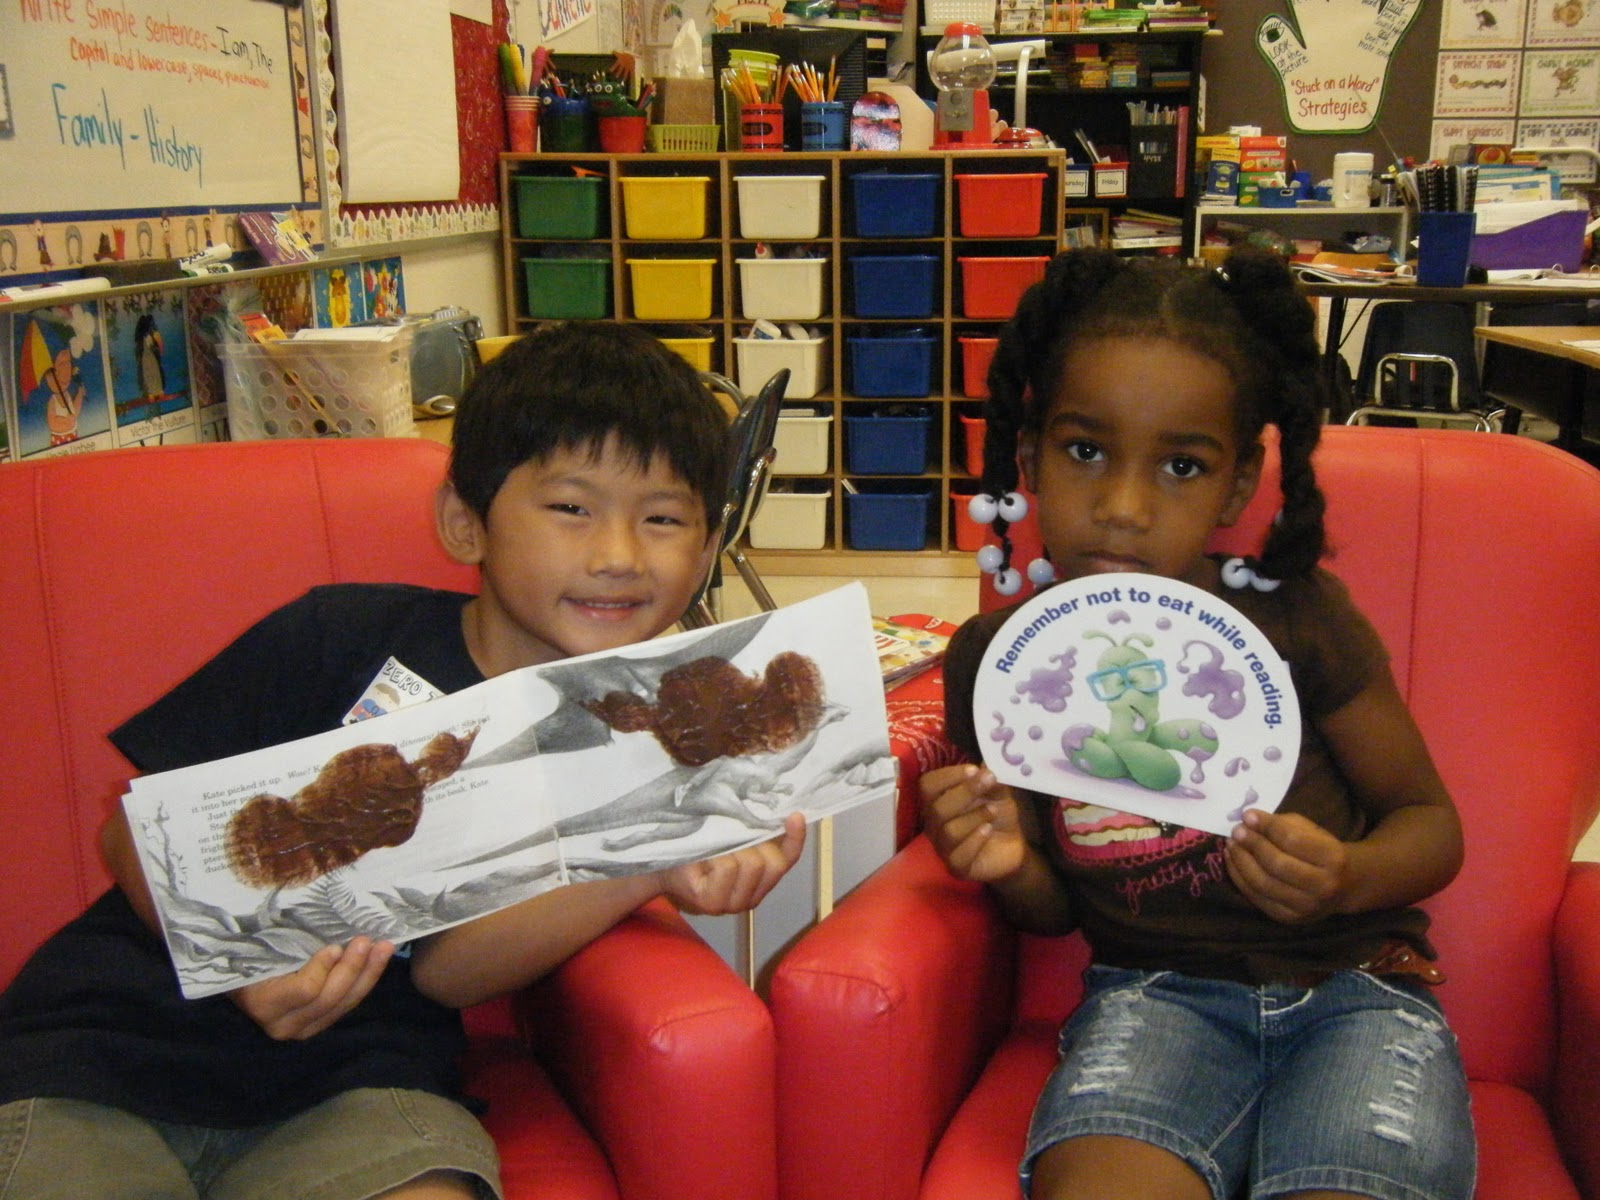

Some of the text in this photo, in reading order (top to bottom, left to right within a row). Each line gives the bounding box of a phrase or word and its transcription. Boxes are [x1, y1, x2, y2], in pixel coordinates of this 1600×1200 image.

[86, 0, 138, 50] Simple
[252, 42, 273, 74] The
[1279, 55, 1309, 81] picture
[1323, 80, 1336, 90] on
[1338, 79, 1347, 91] a
[1298, 97, 1368, 121] Strategies
[51, 82, 125, 170] Family
[143, 102, 203, 189] History
[995, 587, 1283, 729] Remember not to eat while reading.
[382, 661, 423, 696] ZERO
[202, 788, 227, 800] Kate
[227, 781, 257, 796] picked
[288, 767, 312, 779] Wow!
[470, 780, 489, 790] Kate
[201, 801, 220, 812] into
[221, 797, 238, 809] her
[207, 811, 228, 821] Just
